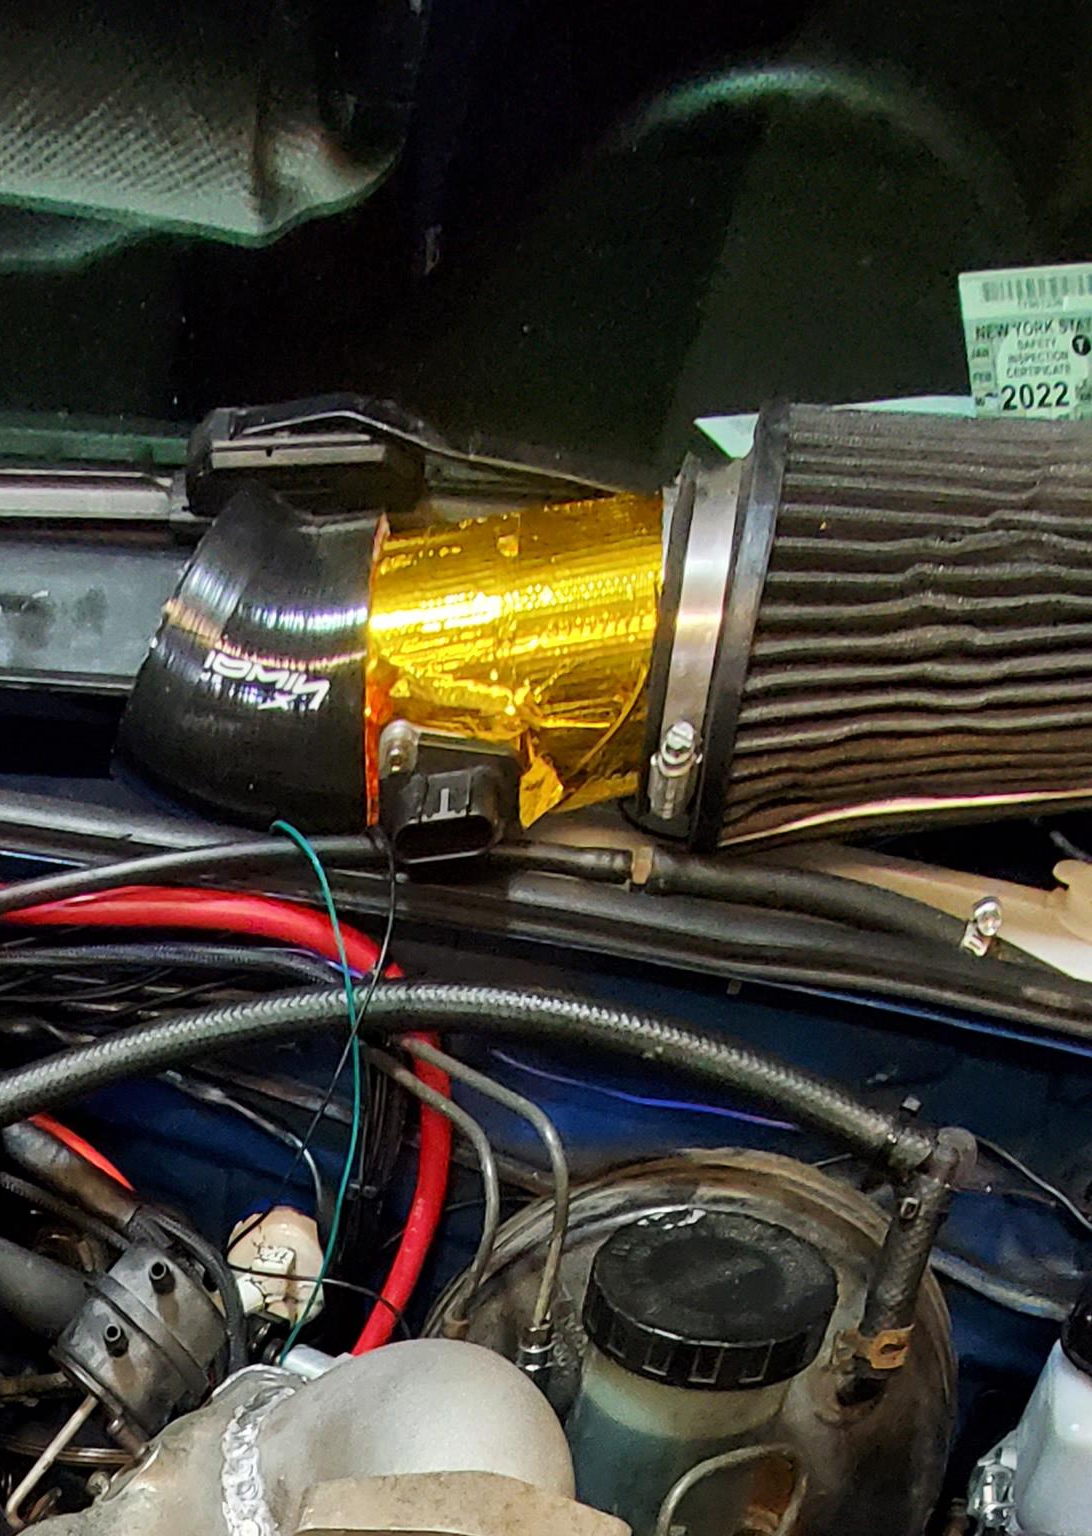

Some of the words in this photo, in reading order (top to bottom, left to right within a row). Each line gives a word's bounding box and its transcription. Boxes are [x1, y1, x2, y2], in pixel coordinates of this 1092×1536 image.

[975, 322, 1009, 341] NEW
[1011, 319, 1053, 338] YORK
[1000, 381, 1070, 411] 2022
